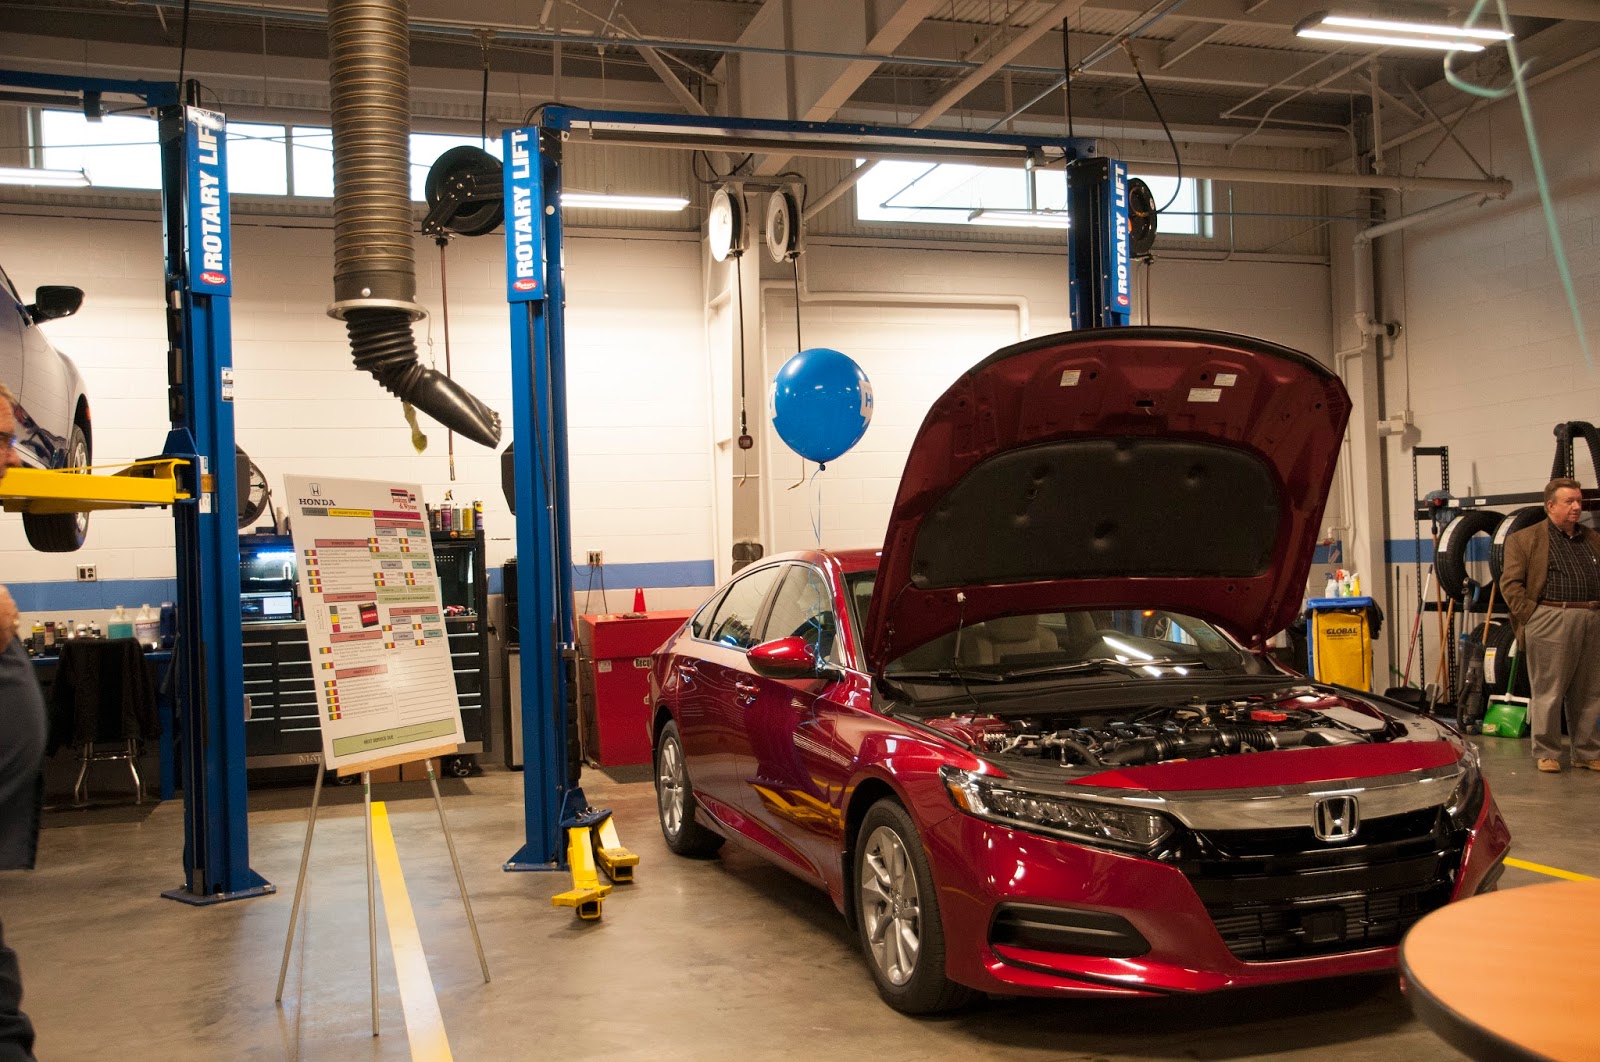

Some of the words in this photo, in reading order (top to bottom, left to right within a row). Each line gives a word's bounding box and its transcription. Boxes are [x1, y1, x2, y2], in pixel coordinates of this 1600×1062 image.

[198, 110, 219, 165] LIF
[511, 131, 530, 179] LIFT
[1115, 164, 1126, 208] LIFT
[199, 169, 223, 271] ROTARY
[514, 186, 534, 278] ROTARY
[1116, 212, 1128, 294] ROTARY
[299, 498, 336, 506] HONDA
[299, 754, 321, 764] MAT
